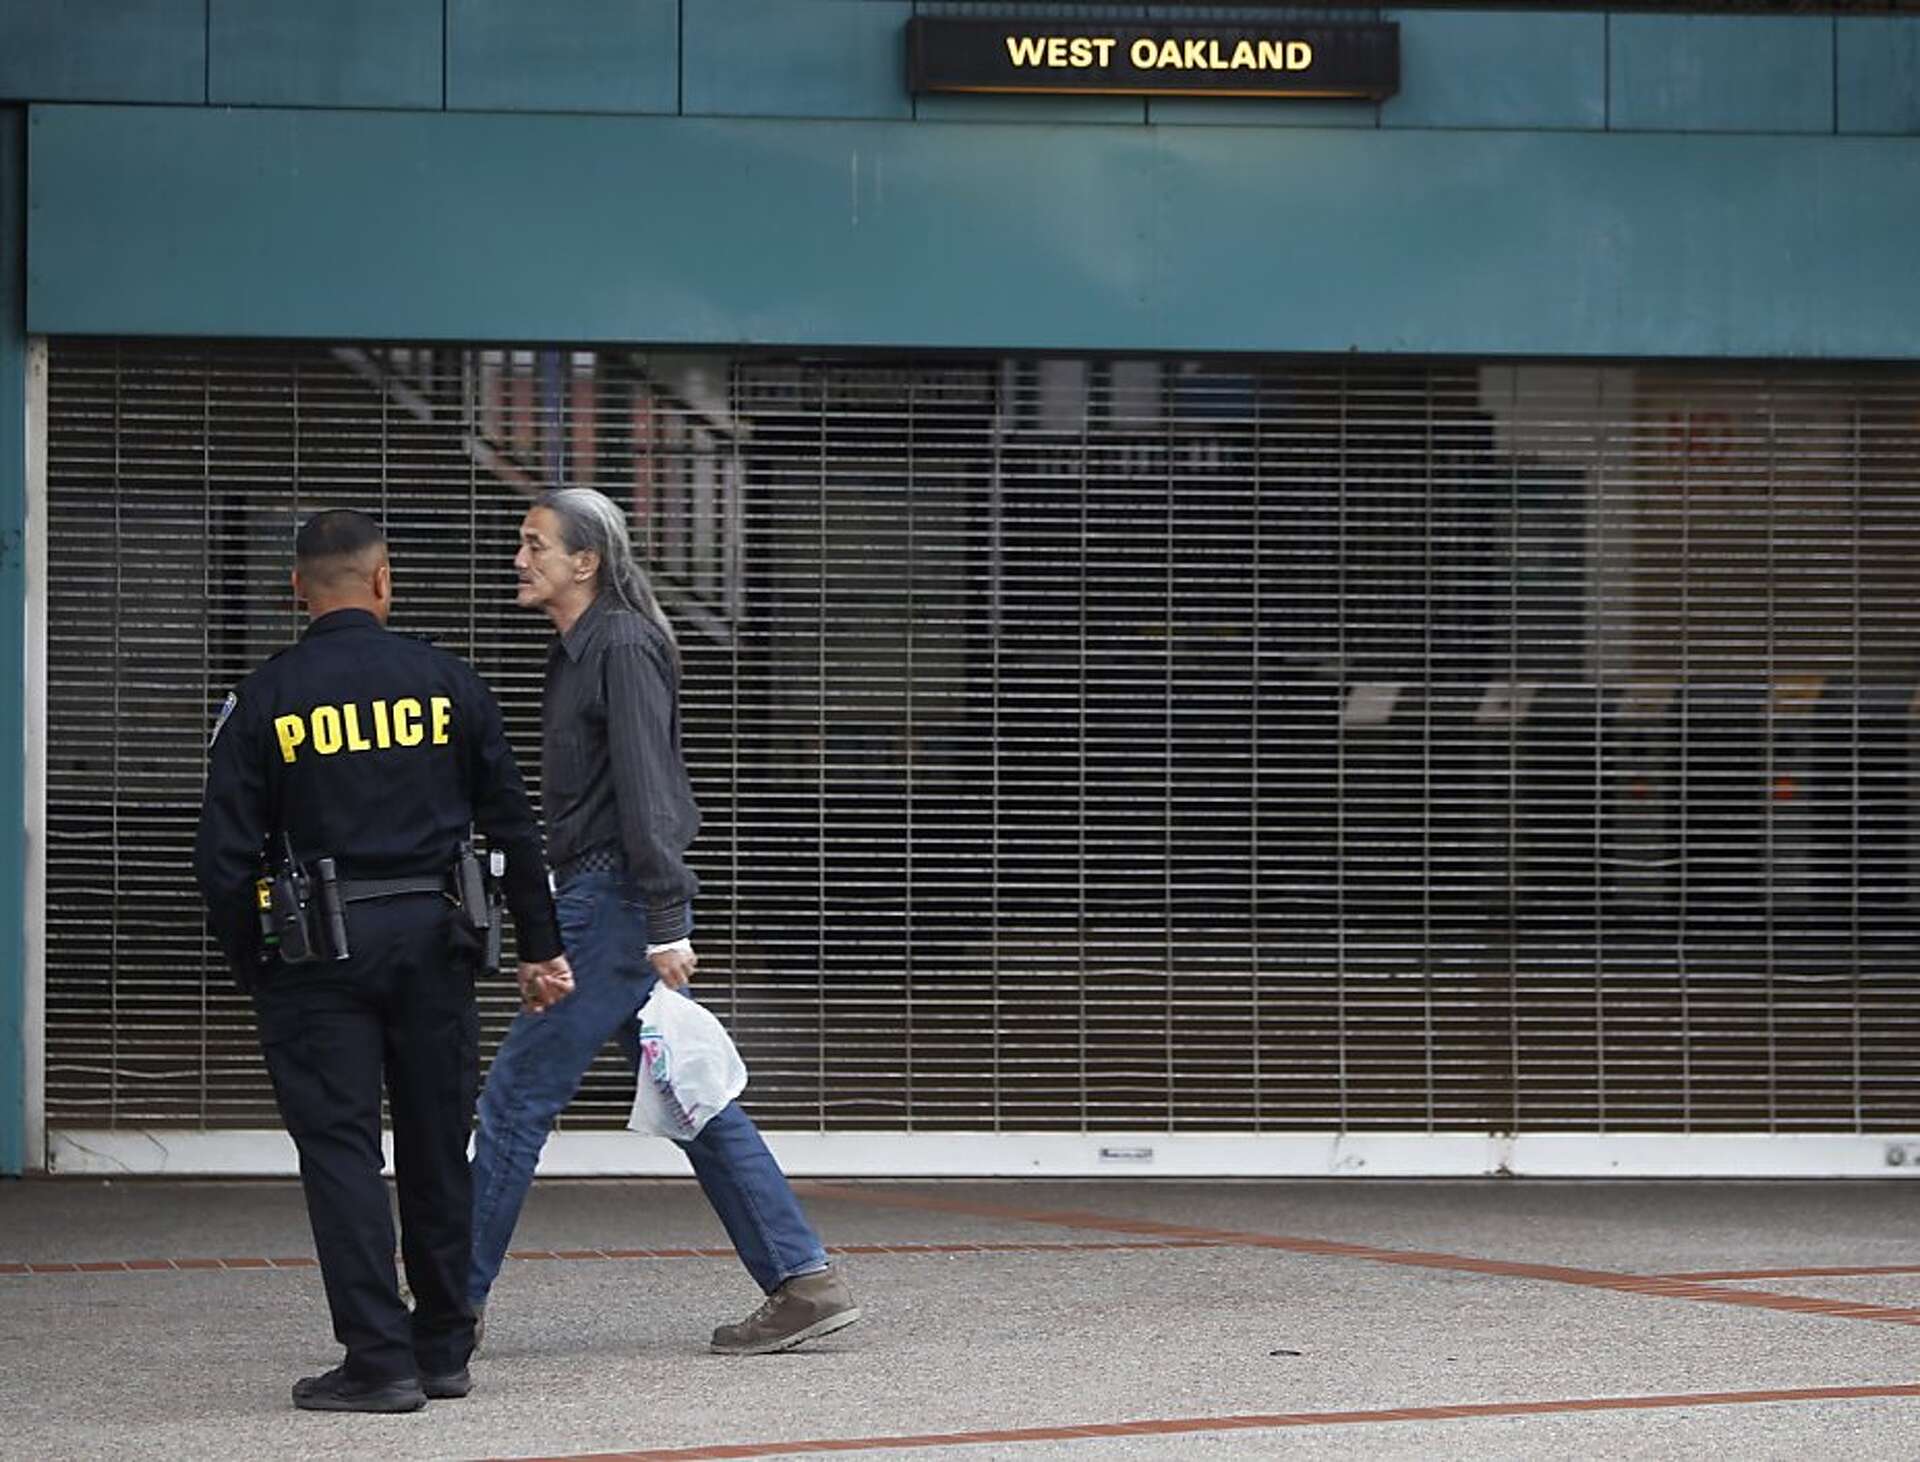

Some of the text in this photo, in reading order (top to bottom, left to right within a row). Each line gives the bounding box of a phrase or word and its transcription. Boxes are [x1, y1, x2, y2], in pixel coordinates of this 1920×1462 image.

[1006, 36, 1313, 70] WEST OAKLAND
[274, 696, 452, 763] POLICE
